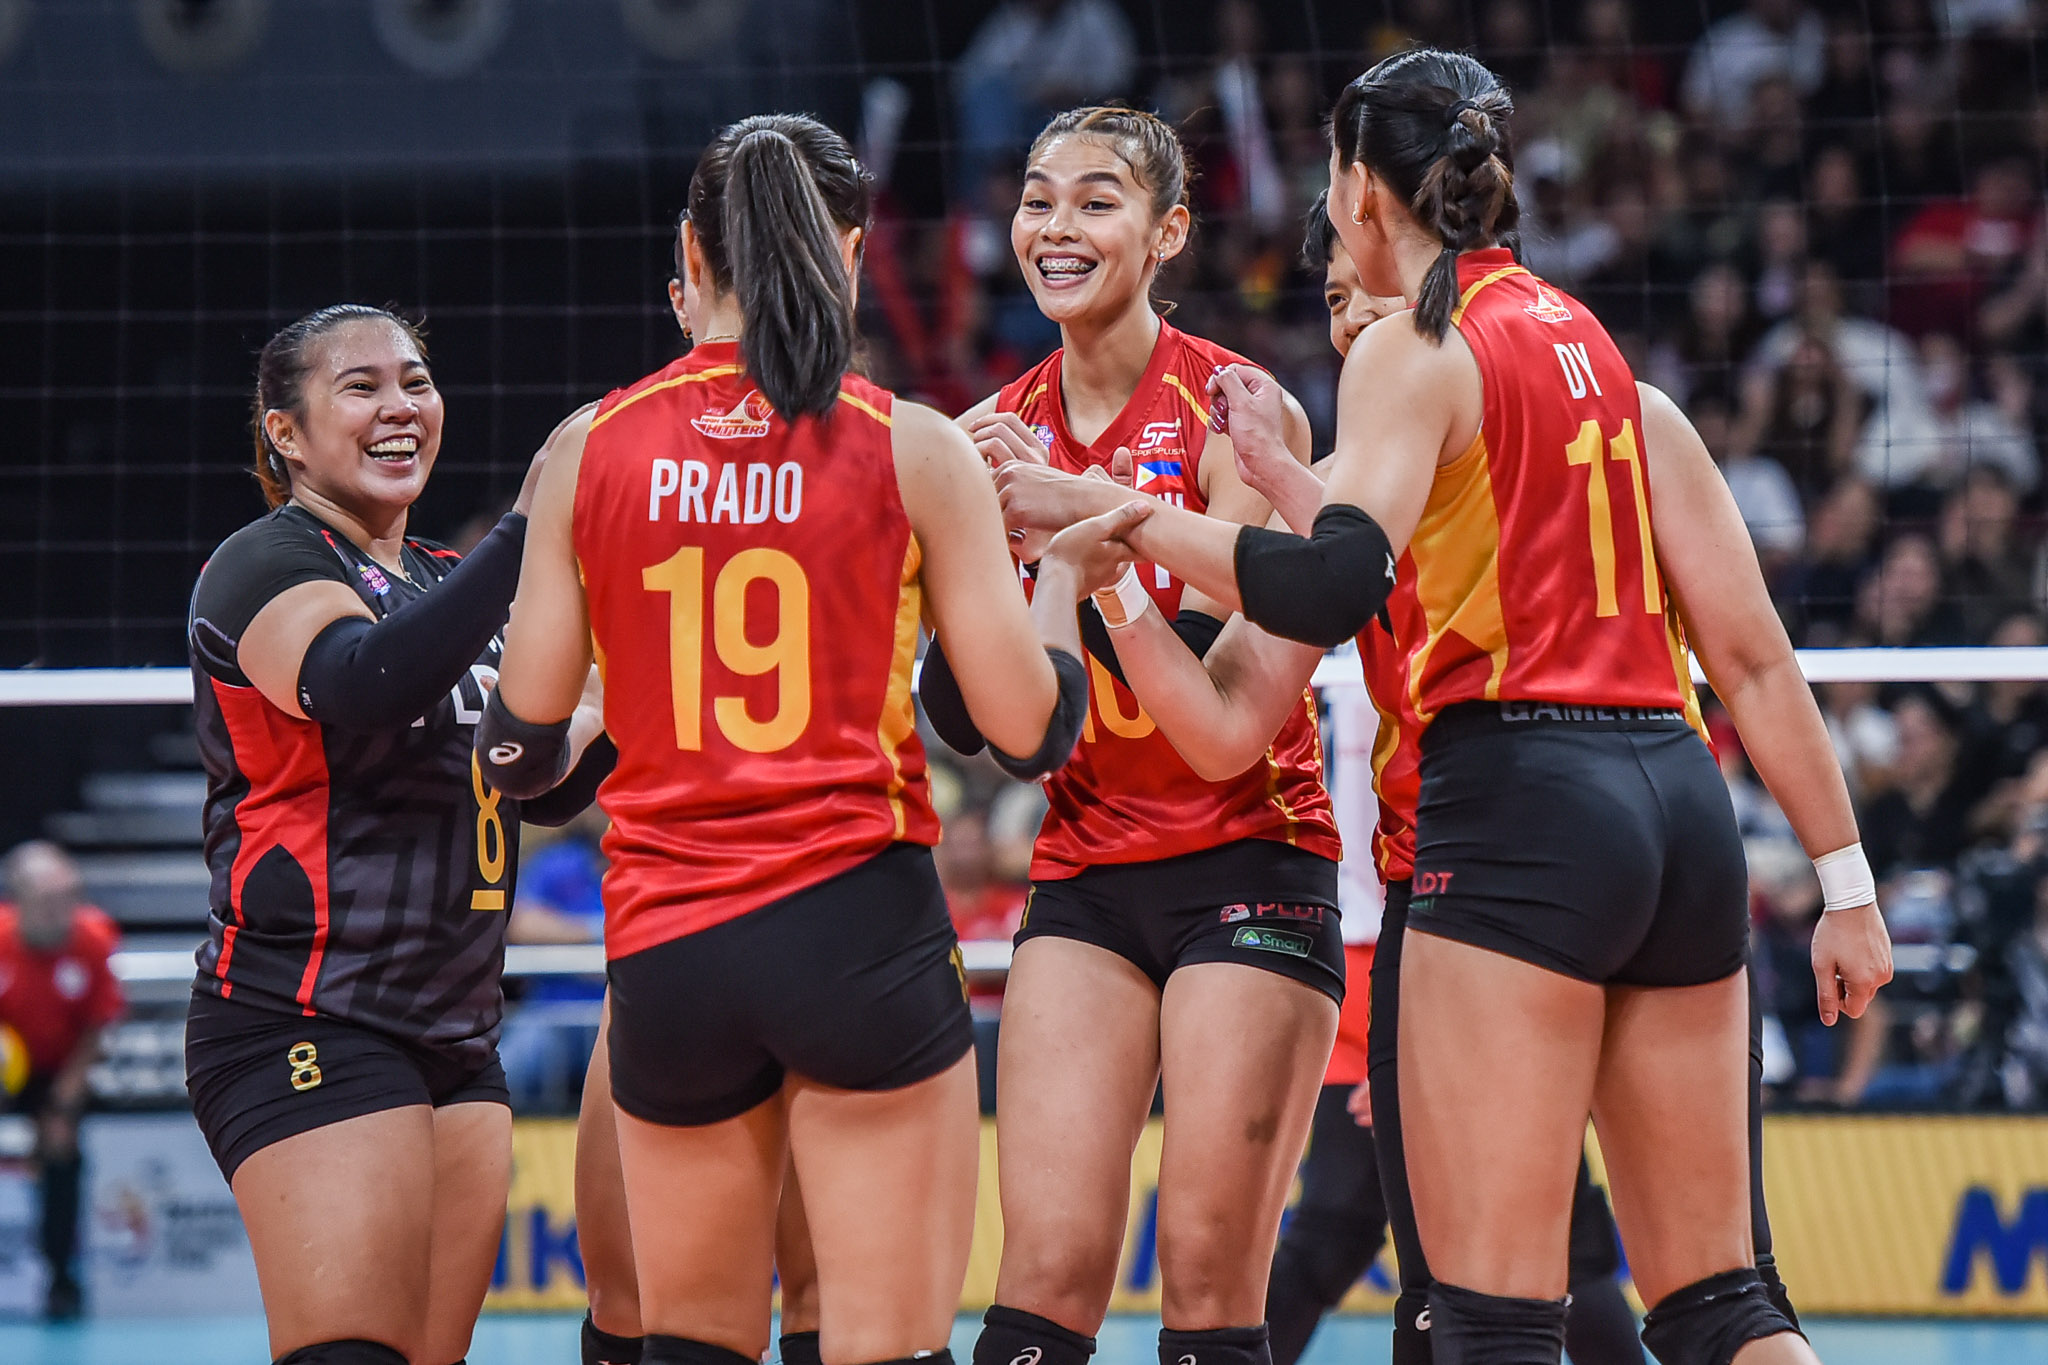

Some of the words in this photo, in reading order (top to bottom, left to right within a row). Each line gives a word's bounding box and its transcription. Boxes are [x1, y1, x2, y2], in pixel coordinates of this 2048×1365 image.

[1553, 342, 1602, 399] DY
[704, 424, 767, 436] HITTERS
[648, 458, 803, 524] PRADO
[1565, 418, 1662, 617] 11
[641, 546, 811, 753] 19
[471, 747, 506, 884] 8
[1413, 872, 1455, 895] LDT
[1261, 933, 1307, 952] Smart
[288, 1042, 322, 1091] 8
